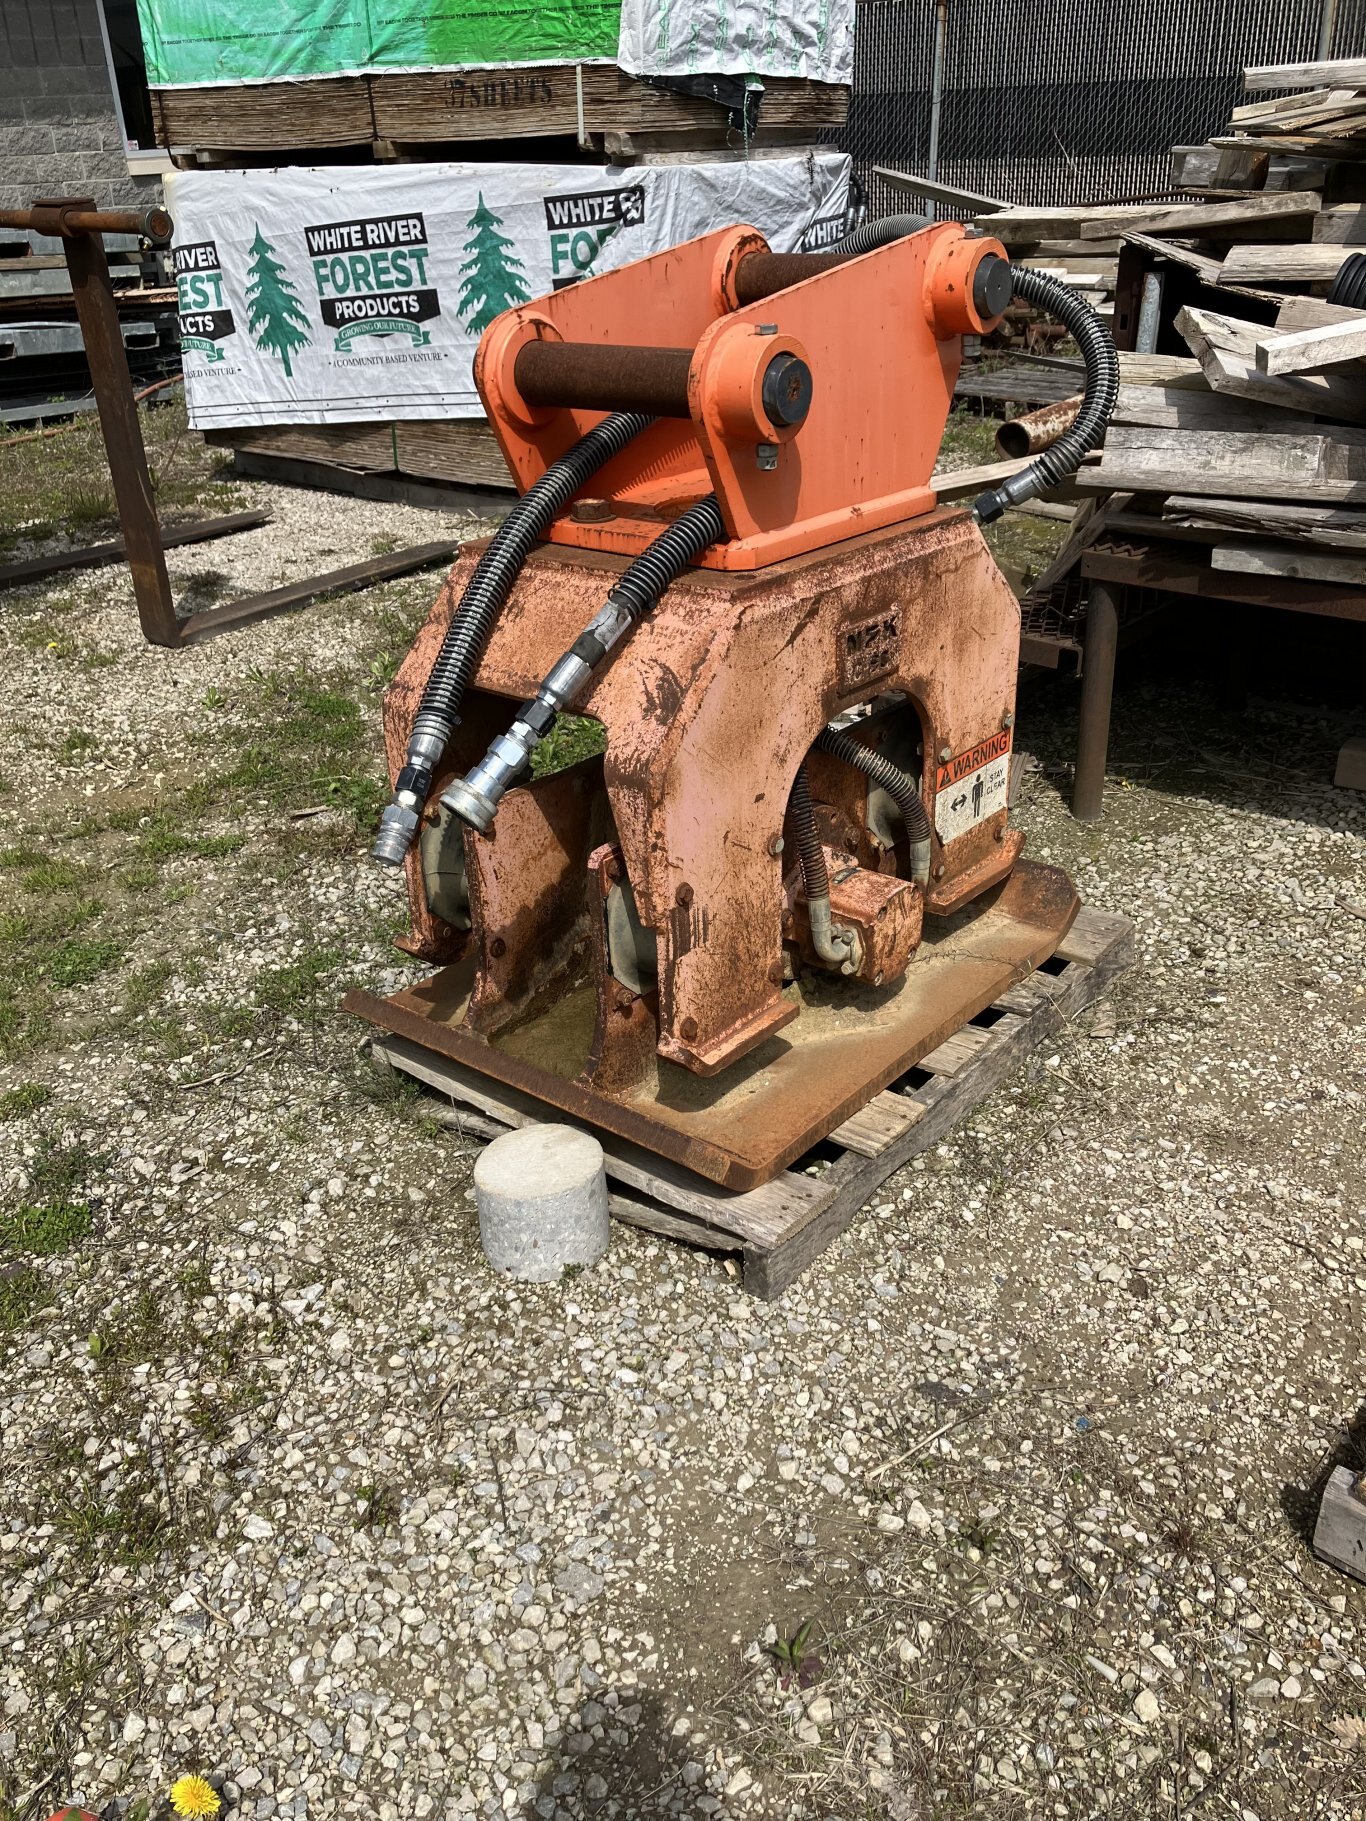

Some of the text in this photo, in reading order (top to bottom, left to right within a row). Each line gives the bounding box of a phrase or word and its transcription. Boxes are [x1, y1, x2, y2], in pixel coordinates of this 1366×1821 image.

[547, 195, 616, 225] WHITE
[307, 218, 423, 252] WHITE RIVER
[175, 246, 218, 271] RIVER
[312, 247, 429, 296] FOREST
[334, 294, 420, 320] PRODUCTS
[341, 320, 417, 339] GROWING OUR FUTURE
[203, 367, 237, 377] VENTURE
[337, 356, 384, 368] COMMUNITY
[385, 354, 408, 364] BASED
[408, 352, 443, 363] VENTURE
[953, 734, 1008, 779] WARNING
[986, 777, 1006, 796] CLEAR
[989, 767, 1004, 783] STAY
